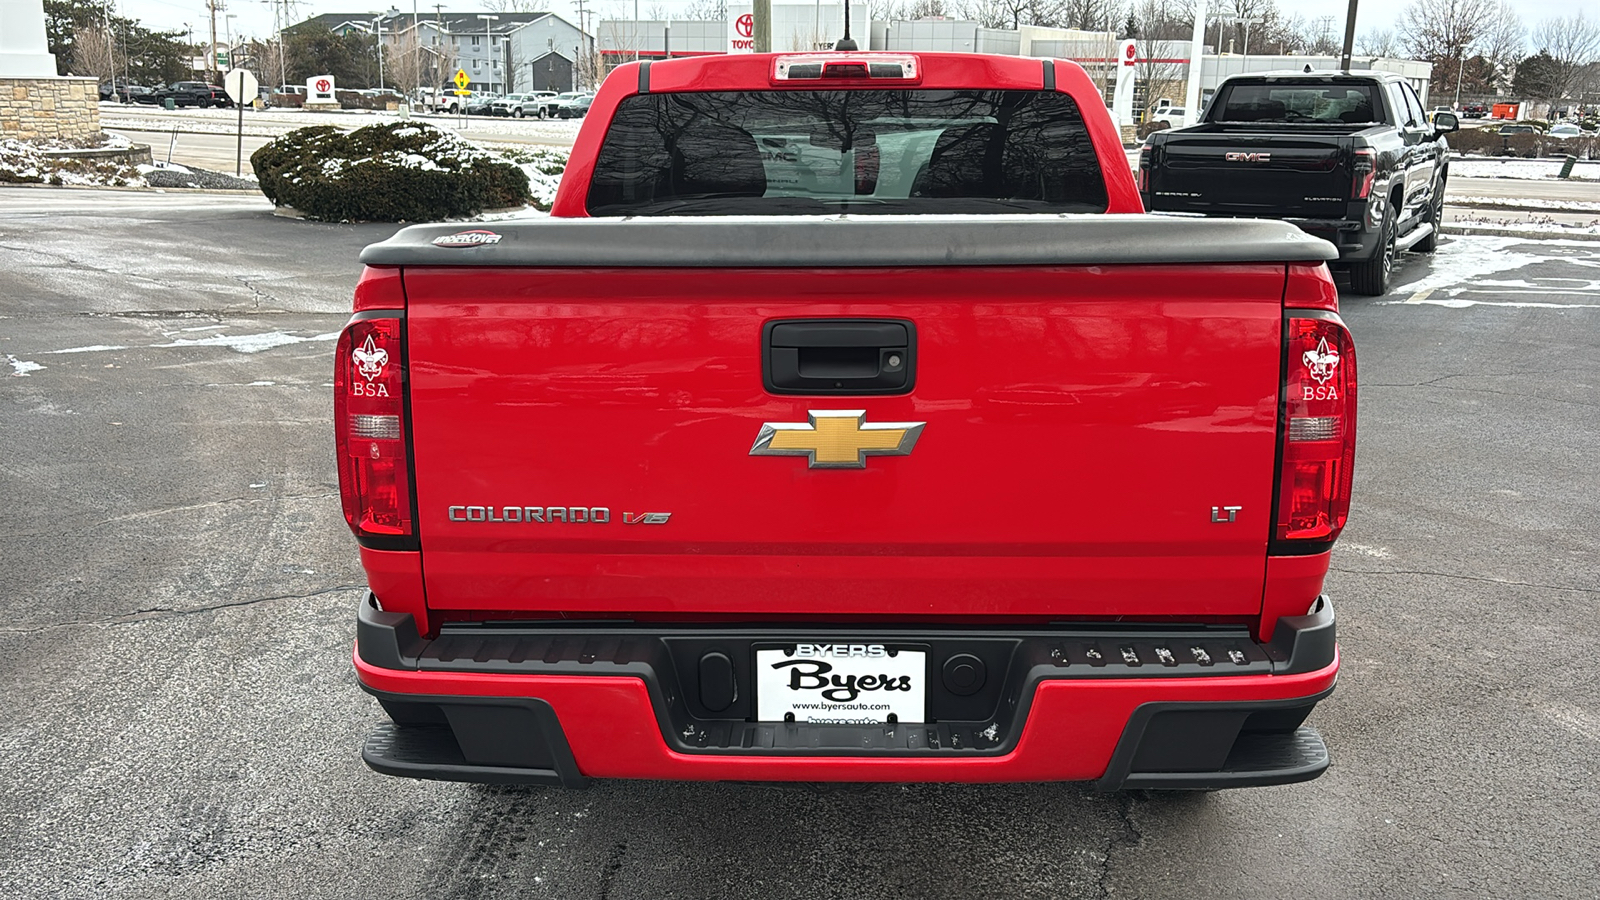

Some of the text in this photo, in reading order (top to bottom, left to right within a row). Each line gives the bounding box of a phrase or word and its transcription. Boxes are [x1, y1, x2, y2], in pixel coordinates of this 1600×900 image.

[731, 40, 754, 50] TOYO
[761, 151, 798, 162] MC
[1225, 152, 1271, 162] GMC
[431, 232, 504, 245] UNDERCOVER
[353, 382, 390, 397] BSA
[1302, 386, 1339, 401] BSA
[448, 505, 672, 524] COLORADO V6
[1211, 505, 1243, 523] LT
[796, 643, 886, 658] BYERS
[770, 659, 912, 702] Byers
[792, 702, 891, 712] www.byersauto.com
